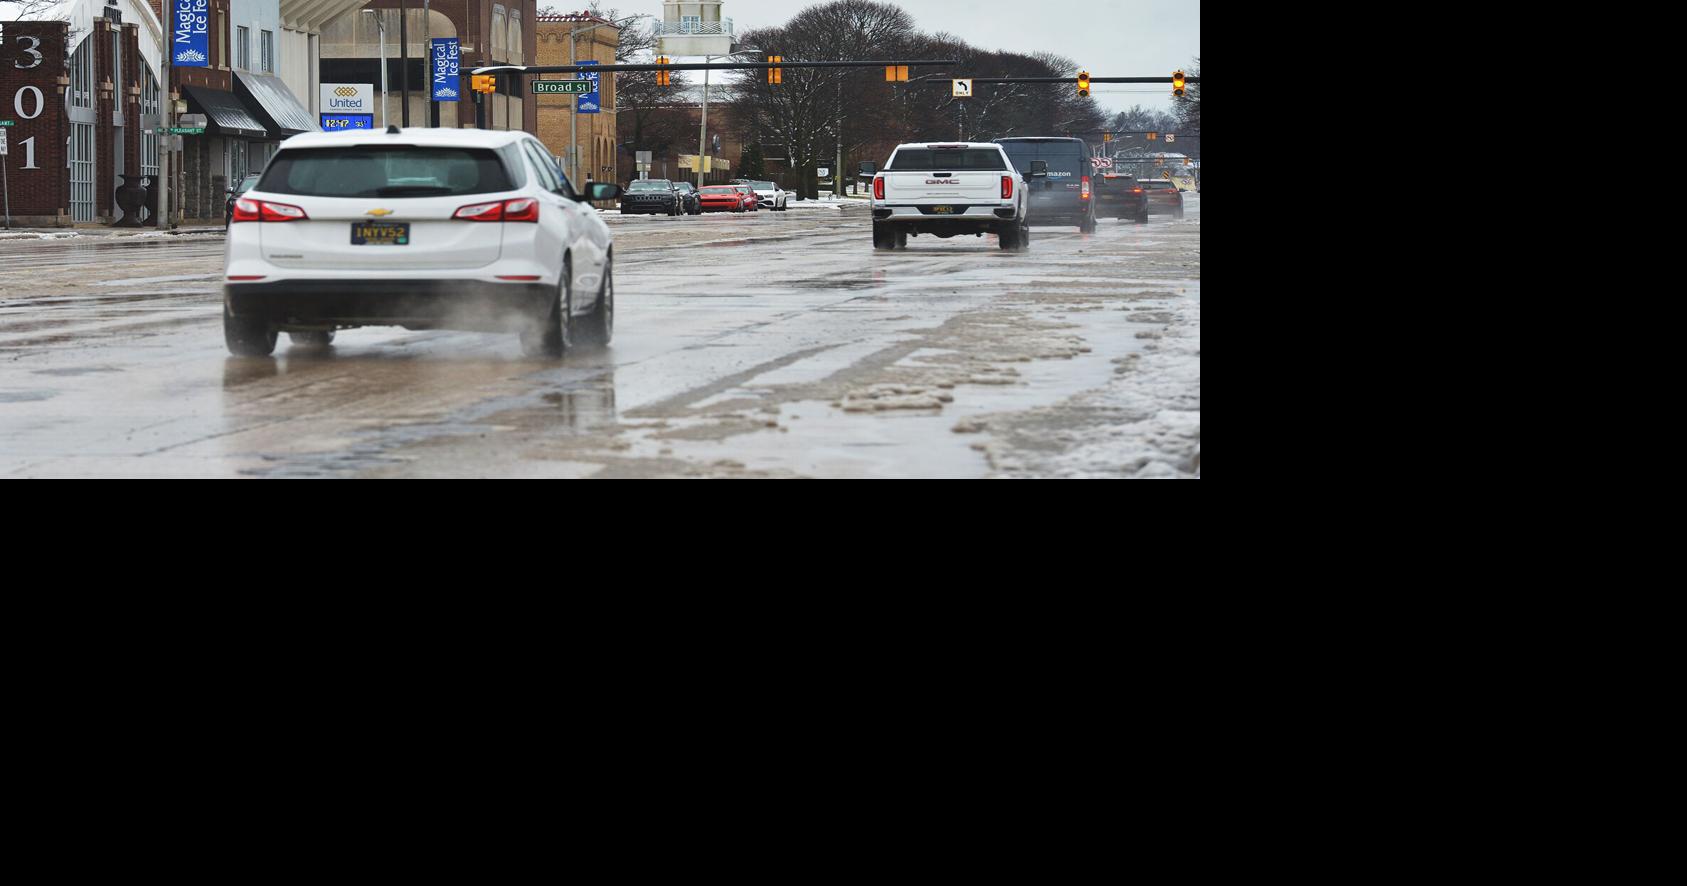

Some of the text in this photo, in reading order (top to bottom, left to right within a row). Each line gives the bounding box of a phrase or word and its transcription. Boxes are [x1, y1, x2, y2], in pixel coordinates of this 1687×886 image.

[175, 0, 196, 44] Magic
[192, 16, 207, 34] Ice
[433, 43, 450, 84] Magical
[446, 41, 459, 76] Ice Fest
[537, 82, 586, 92] Broad St
[329, 98, 362, 108] United
